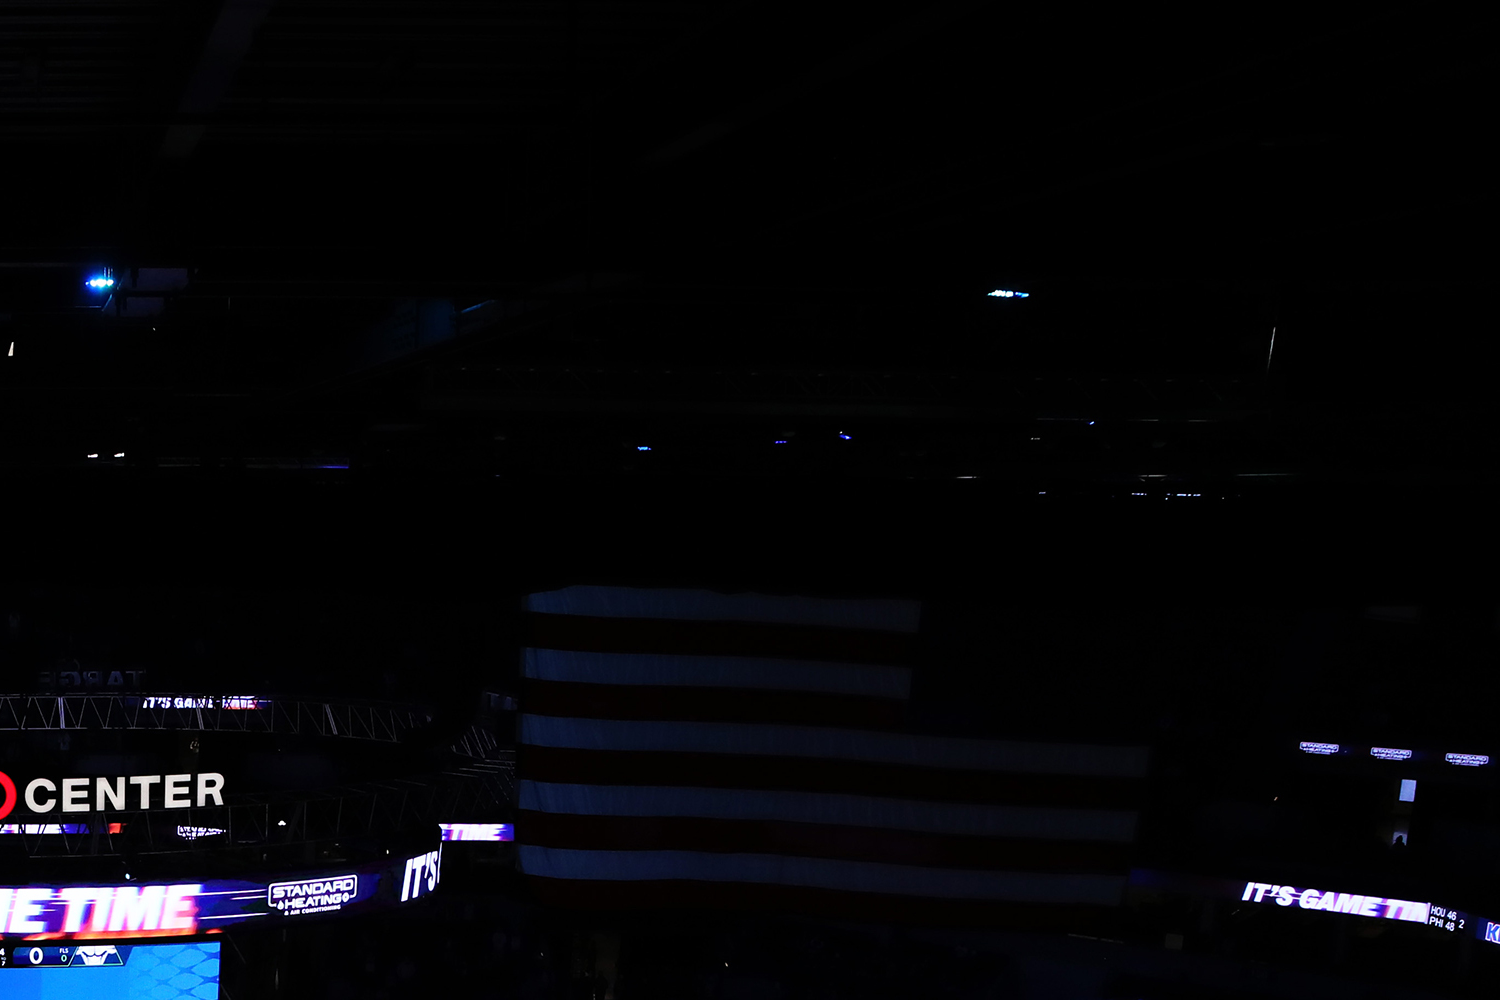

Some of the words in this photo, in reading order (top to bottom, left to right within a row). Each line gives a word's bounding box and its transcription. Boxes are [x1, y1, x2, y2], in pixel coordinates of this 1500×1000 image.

[25, 773, 225, 812] CENTER
[450, 824, 504, 840] TIME
[401, 850, 438, 902] IT'S
[272, 879, 354, 899] STANDARD
[58, 884, 204, 933] TIME
[284, 893, 343, 909] HEATING
[1242, 882, 1296, 906] IT'S
[1299, 889, 1383, 918] GAME
[301, 904, 341, 914] CONDITIONING
[1431, 906, 1446, 917] HOU
[1447, 911, 1457, 920] 46
[1429, 916, 1444, 928] PHI
[1445, 921, 1455, 931] 48
[1459, 919, 1465, 929] 2
[29, 947, 43, 965] 0
